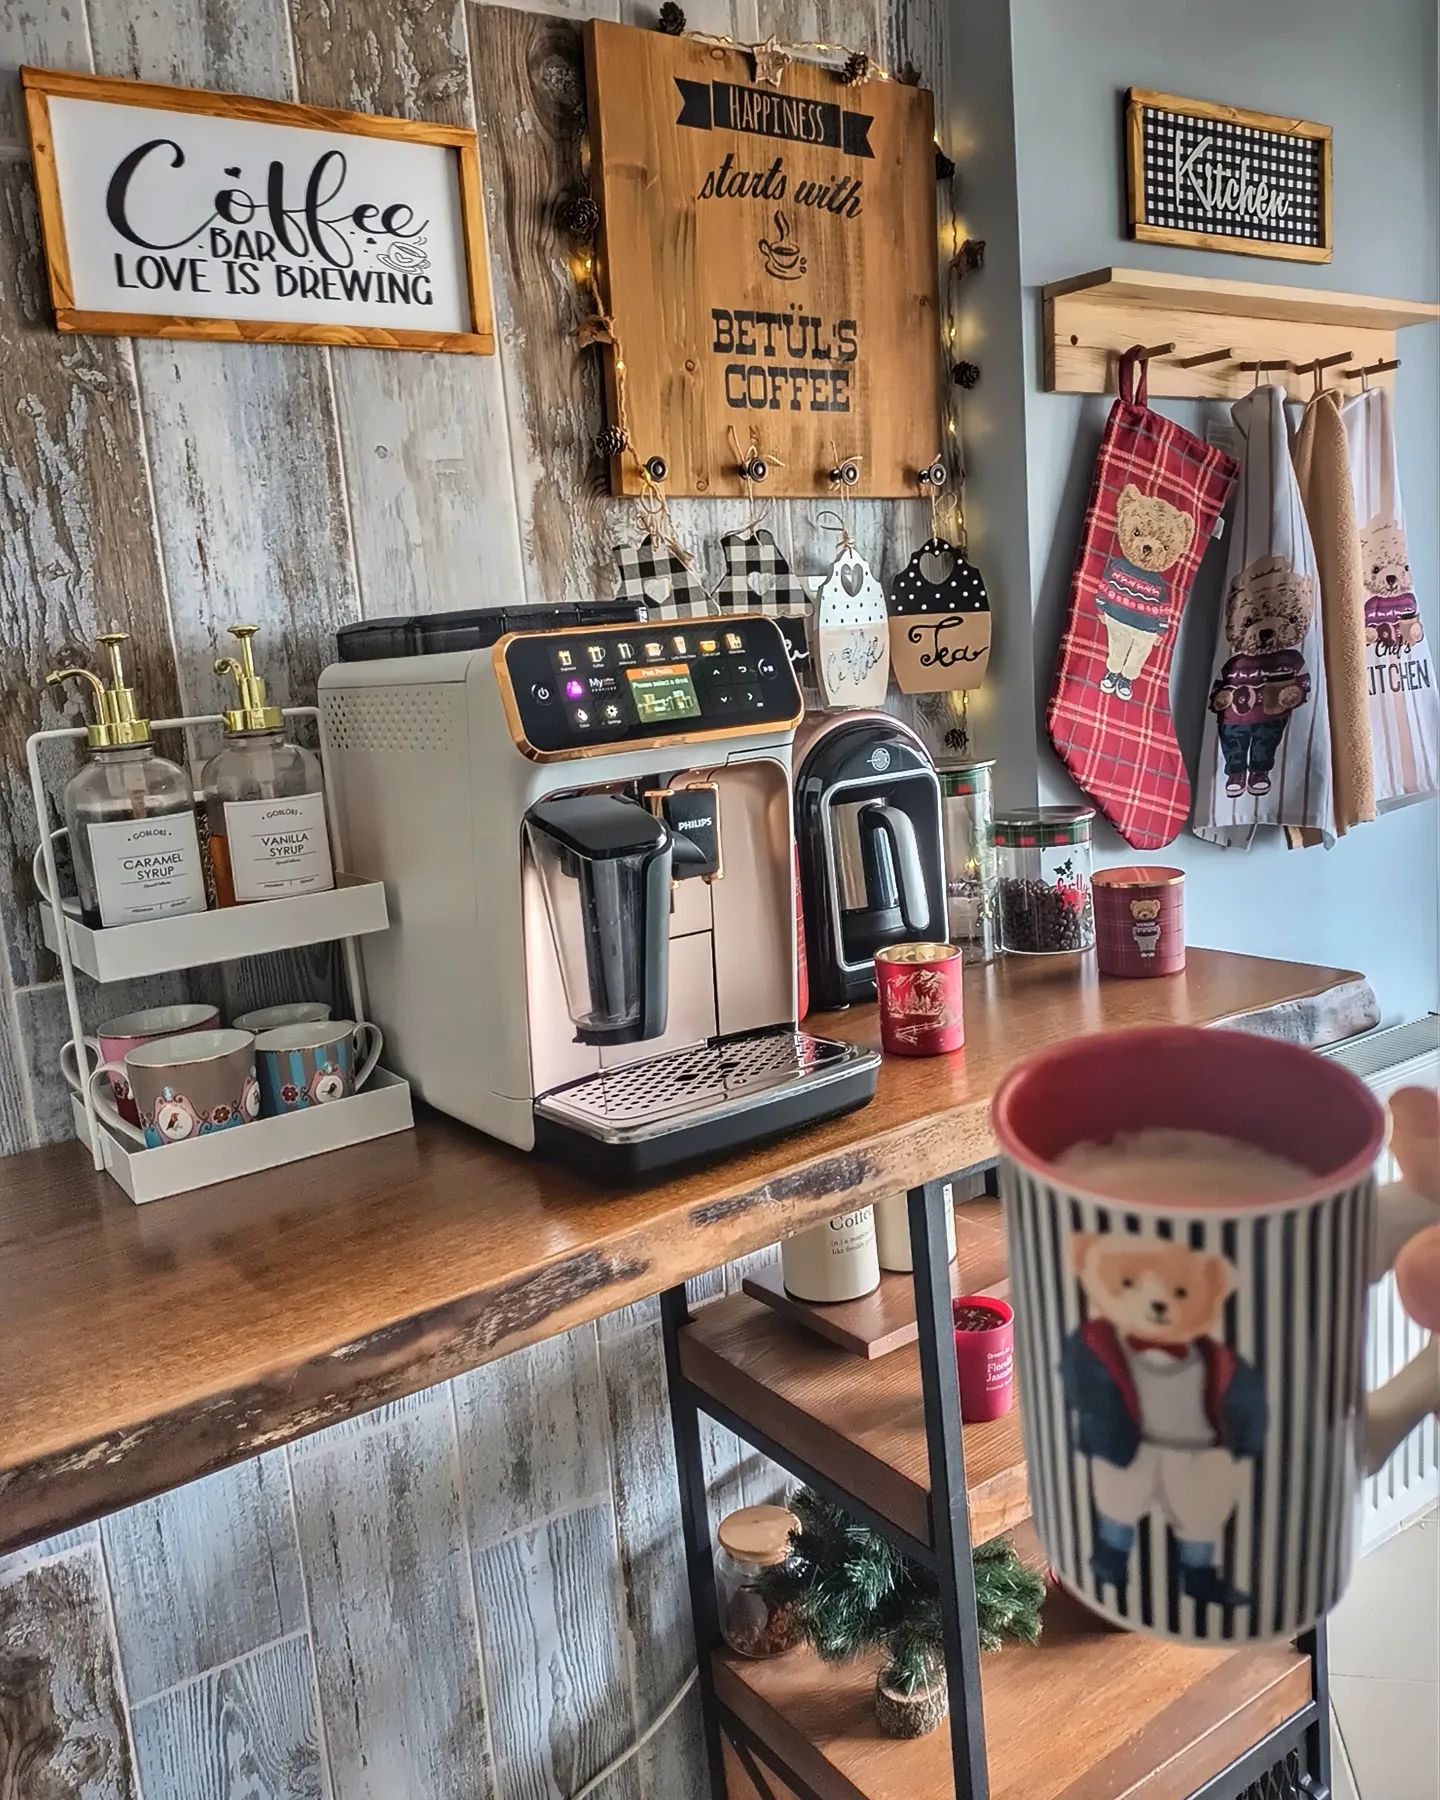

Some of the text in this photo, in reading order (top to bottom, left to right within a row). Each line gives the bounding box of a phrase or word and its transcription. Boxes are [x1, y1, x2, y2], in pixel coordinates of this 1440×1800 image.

[729, 85, 826, 143] HAPPINESS
[697, 153, 863, 219] starts with
[1175, 130, 1289, 220] Kitchen
[106, 138, 430, 269] Coffee
[210, 227, 277, 262] BAR
[115, 253, 433, 306] LOVE IS BREWING
[724, 363, 851, 413] COFFEE
[908, 615, 989, 668] Tea
[1369, 659, 1430, 695] ITCHEN
[261, 833, 309, 846] VANILLA
[678, 817, 712, 831] PHILIPS
[123, 853, 183, 870] CARAMEL
[269, 844, 304, 857] SYRUP
[137, 865, 174, 880] SYRUP
